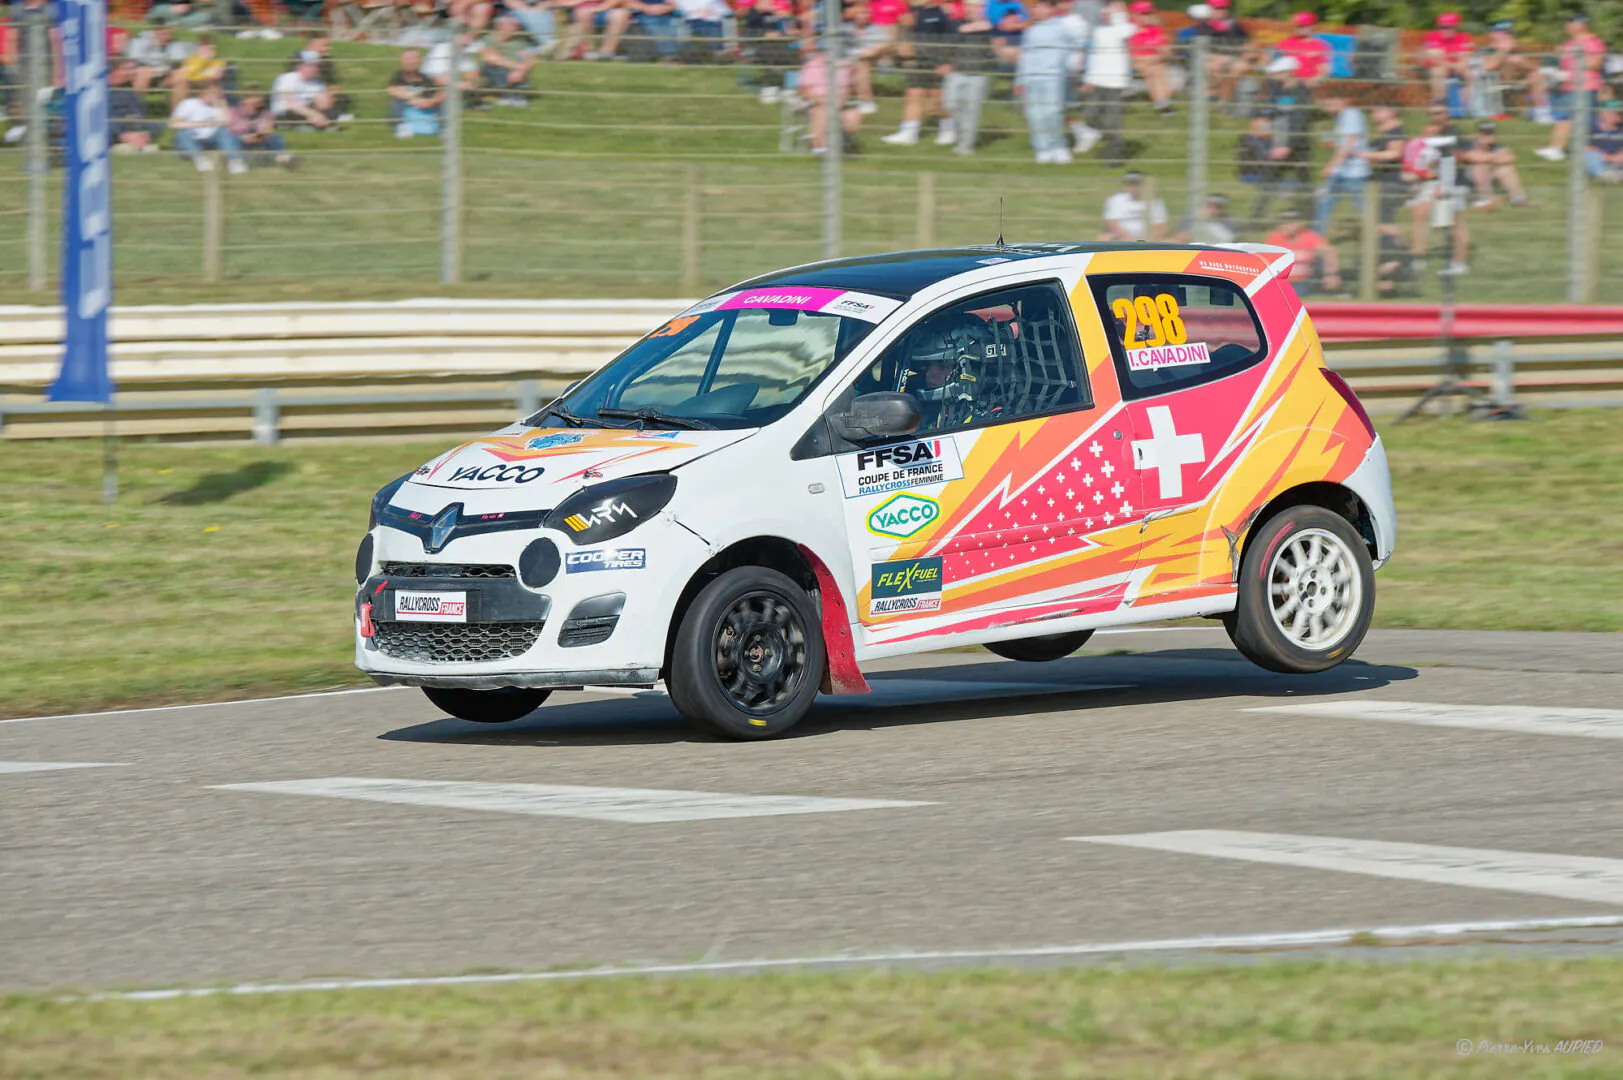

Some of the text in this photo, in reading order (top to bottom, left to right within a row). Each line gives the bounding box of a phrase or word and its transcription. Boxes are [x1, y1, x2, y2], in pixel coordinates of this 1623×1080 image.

[743, 294, 813, 305] CAVADINI
[840, 300, 870, 309] FFSA
[1112, 293, 1188, 350] 298
[1128, 344, 1208, 367] I.CAVADINI
[857, 442, 934, 471] FFSA
[447, 464, 546, 483] YACCO
[858, 463, 944, 486] COUPE DE FRANCE
[875, 504, 933, 528] YACCO
[566, 550, 645, 565] COOER
[603, 560, 642, 569] TIRES
[400, 596, 464, 615] RALLYCROSS FRANCE
[874, 597, 940, 613] RALLYCROSS FRANCE
